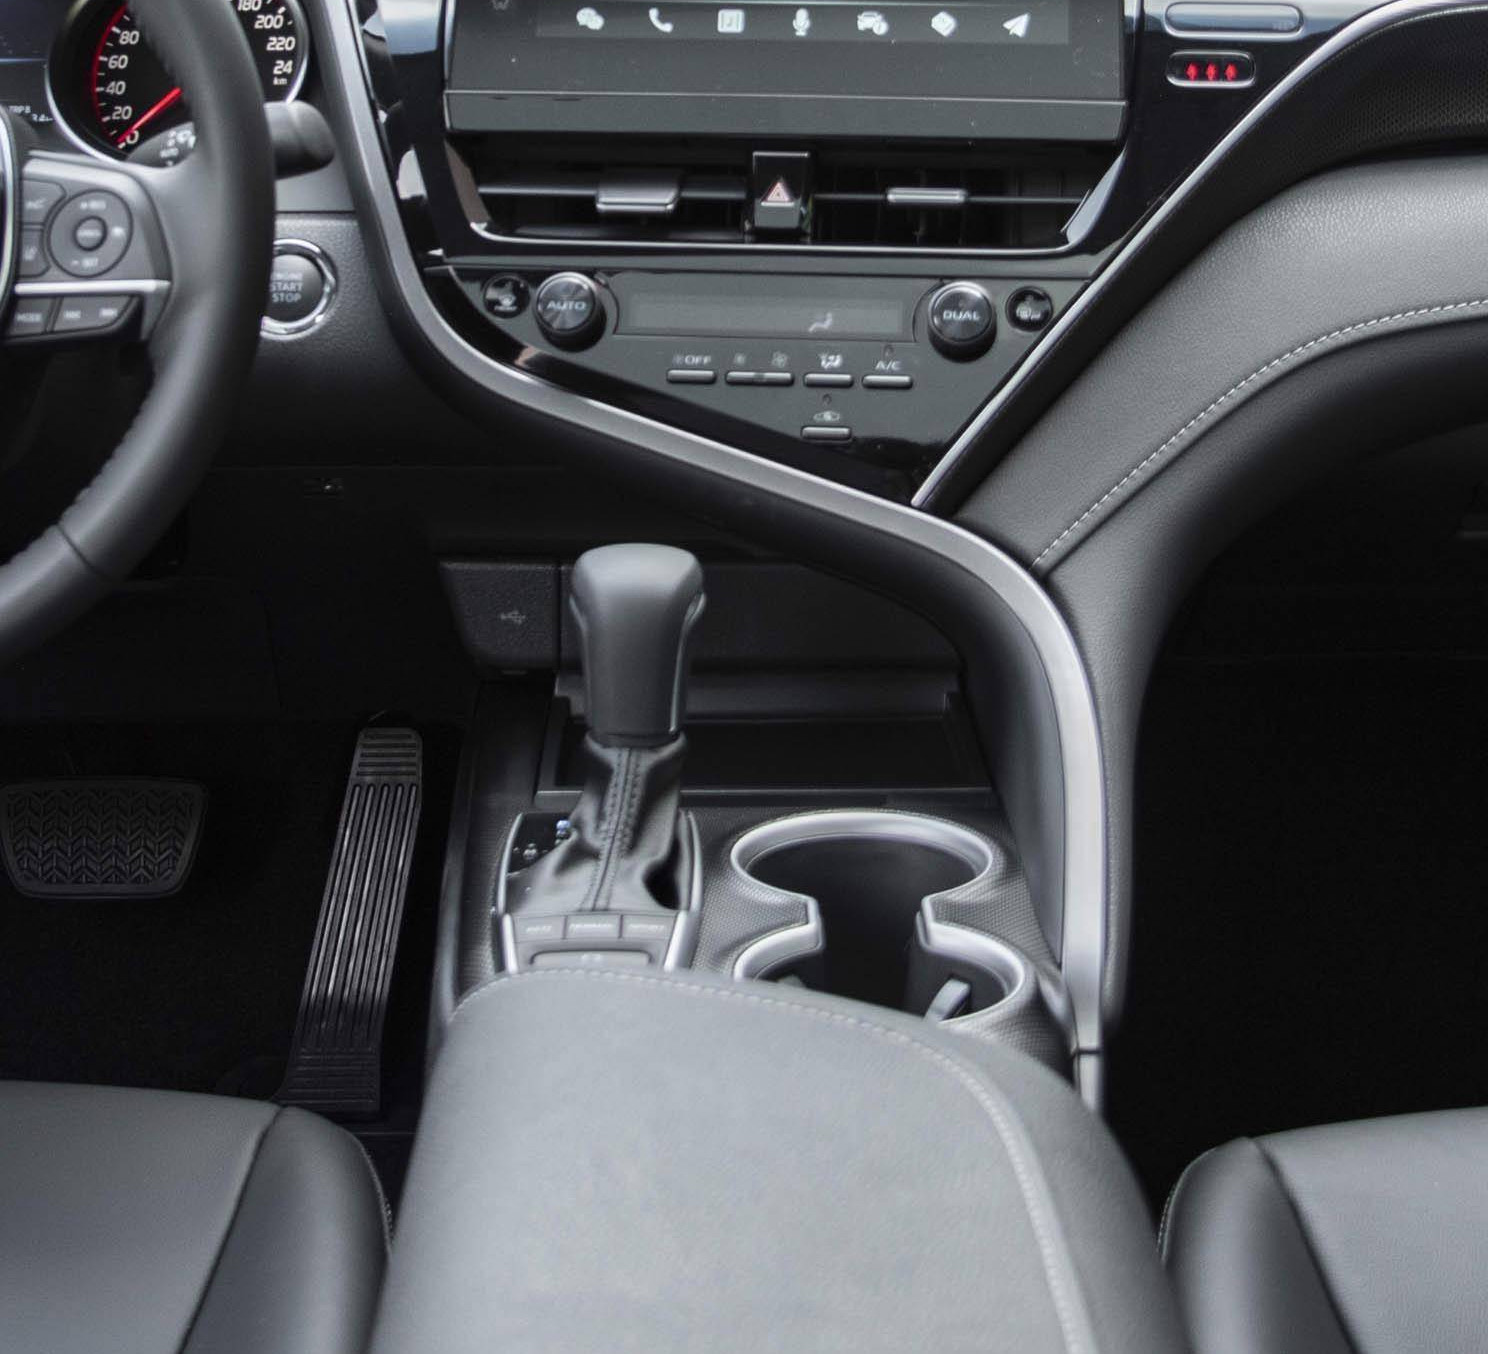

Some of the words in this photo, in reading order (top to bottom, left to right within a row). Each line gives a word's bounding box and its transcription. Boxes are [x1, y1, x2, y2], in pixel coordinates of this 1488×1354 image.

[254, 14, 284, 30] 200
[119, 30, 140, 45] 80
[266, 36, 296, 51] 220
[108, 55, 129, 70] 60
[105, 80, 127, 95] 40
[111, 105, 133, 120] 20
[270, 281, 303, 292] START
[272, 293, 302, 303] STOP
[546, 300, 587, 311] AUTO
[942, 309, 981, 322] DUAL
[685, 355, 712, 365] OFF
[875, 360, 902, 371] A/C
